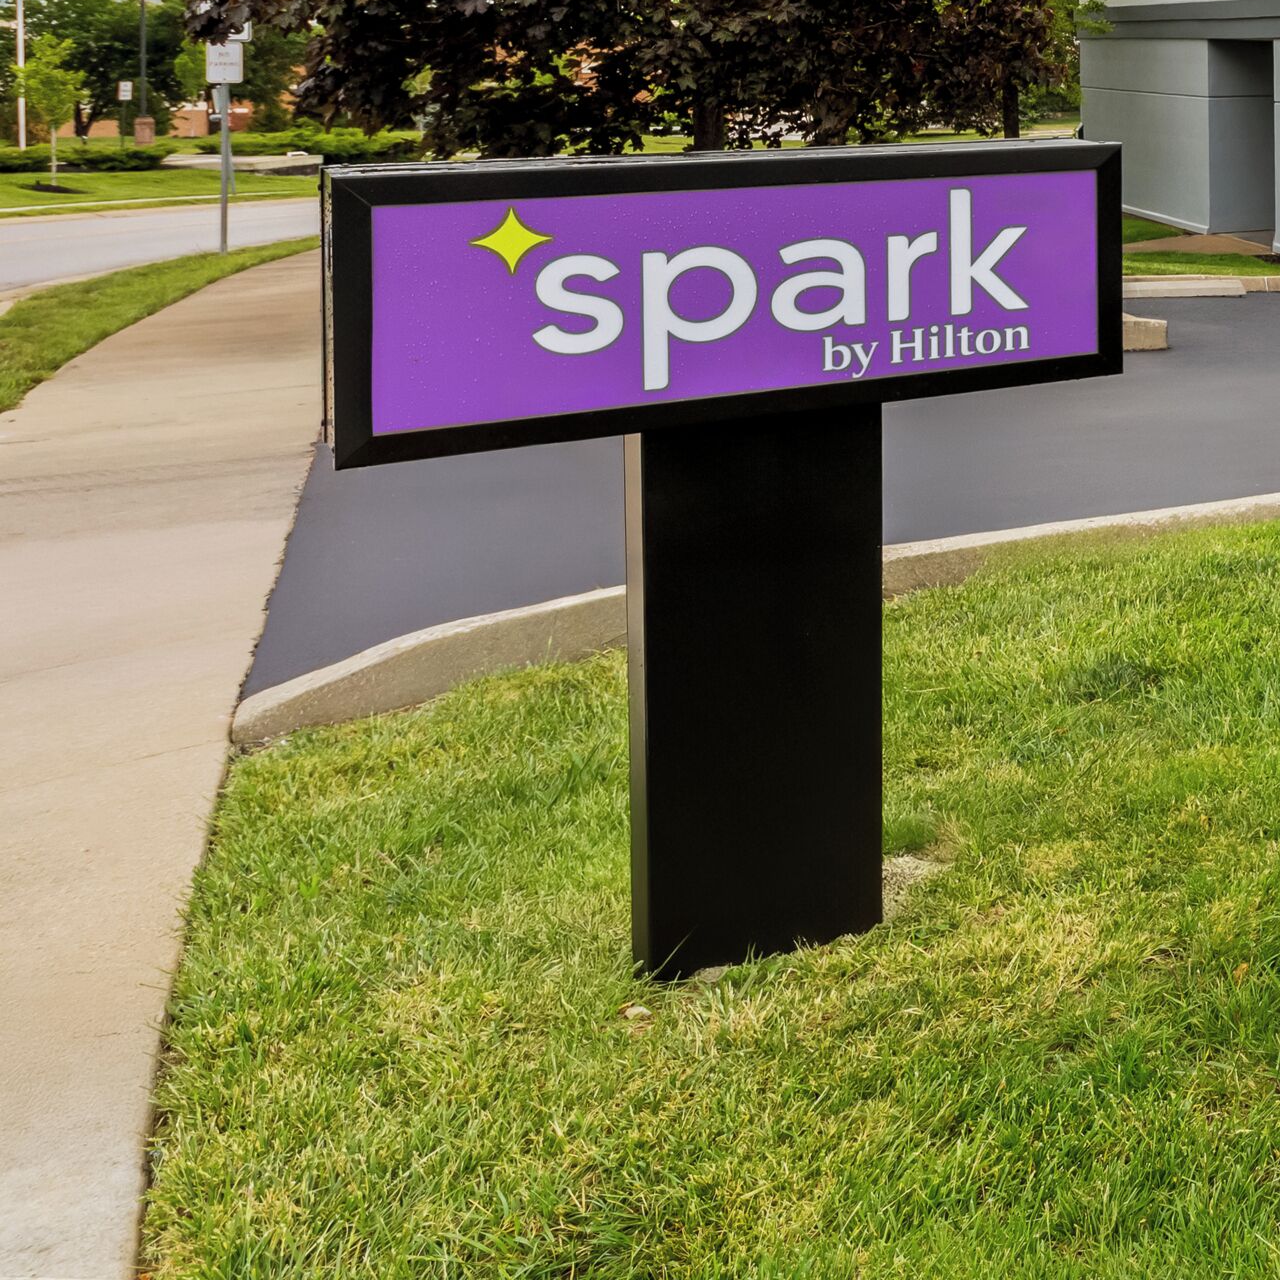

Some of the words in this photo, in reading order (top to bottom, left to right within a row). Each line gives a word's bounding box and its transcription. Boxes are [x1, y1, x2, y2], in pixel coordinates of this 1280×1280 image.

[531, 187, 1030, 391] spark
[822, 336, 877, 378] by
[890, 324, 1031, 365] Hilton
